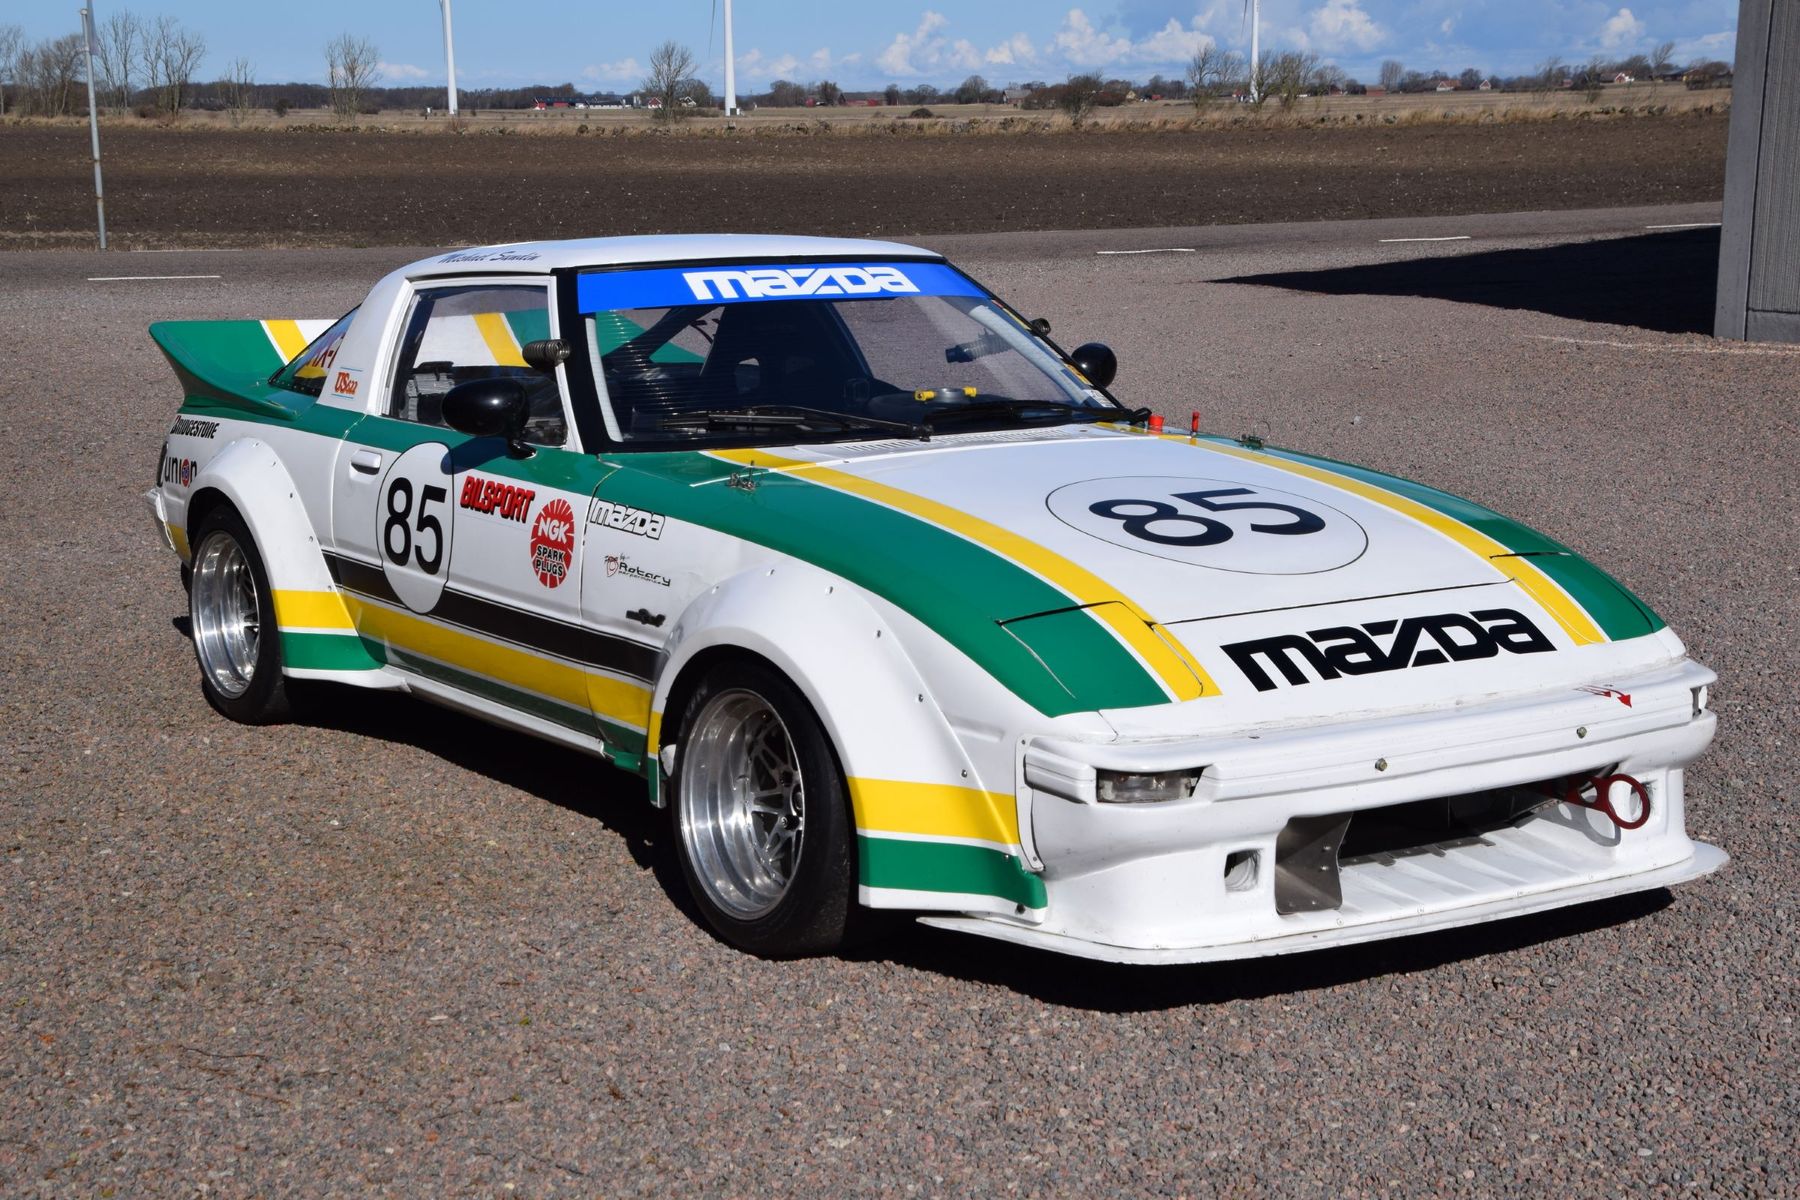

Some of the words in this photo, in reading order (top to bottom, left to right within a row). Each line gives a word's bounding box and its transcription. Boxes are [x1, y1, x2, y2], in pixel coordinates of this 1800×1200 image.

[460, 475, 536, 524] BILSPORT
[384, 477, 447, 575] 85
[537, 516, 570, 544] NGK
[1088, 487, 1326, 547] 85
[536, 544, 566, 562] SPARK
[535, 559, 564, 577] PLUGS
[619, 561, 671, 588] Rotary
